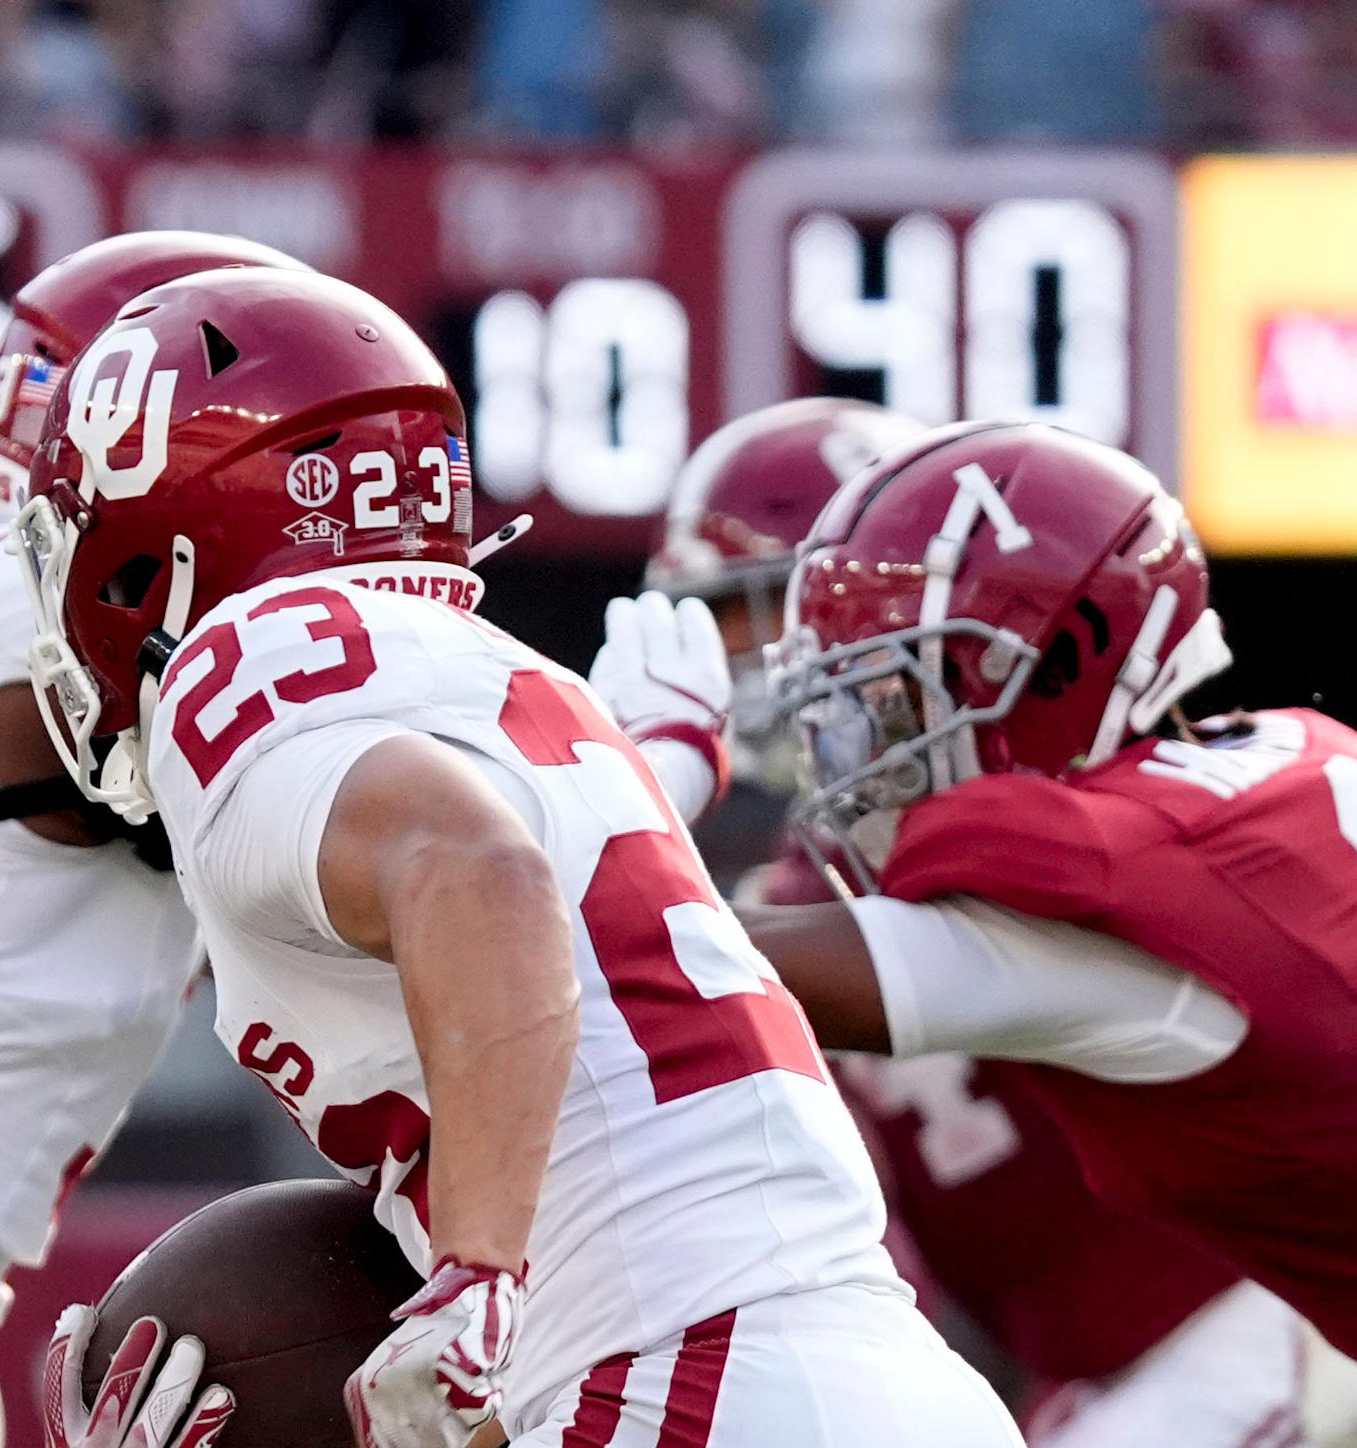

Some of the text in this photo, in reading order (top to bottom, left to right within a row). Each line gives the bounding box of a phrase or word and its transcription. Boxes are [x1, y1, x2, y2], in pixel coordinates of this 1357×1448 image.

[473, 278, 691, 518] 10
[789, 200, 1133, 448] 40
[292, 458, 334, 502] SEC
[349, 446, 451, 530] 23
[158, 586, 377, 790] 23
